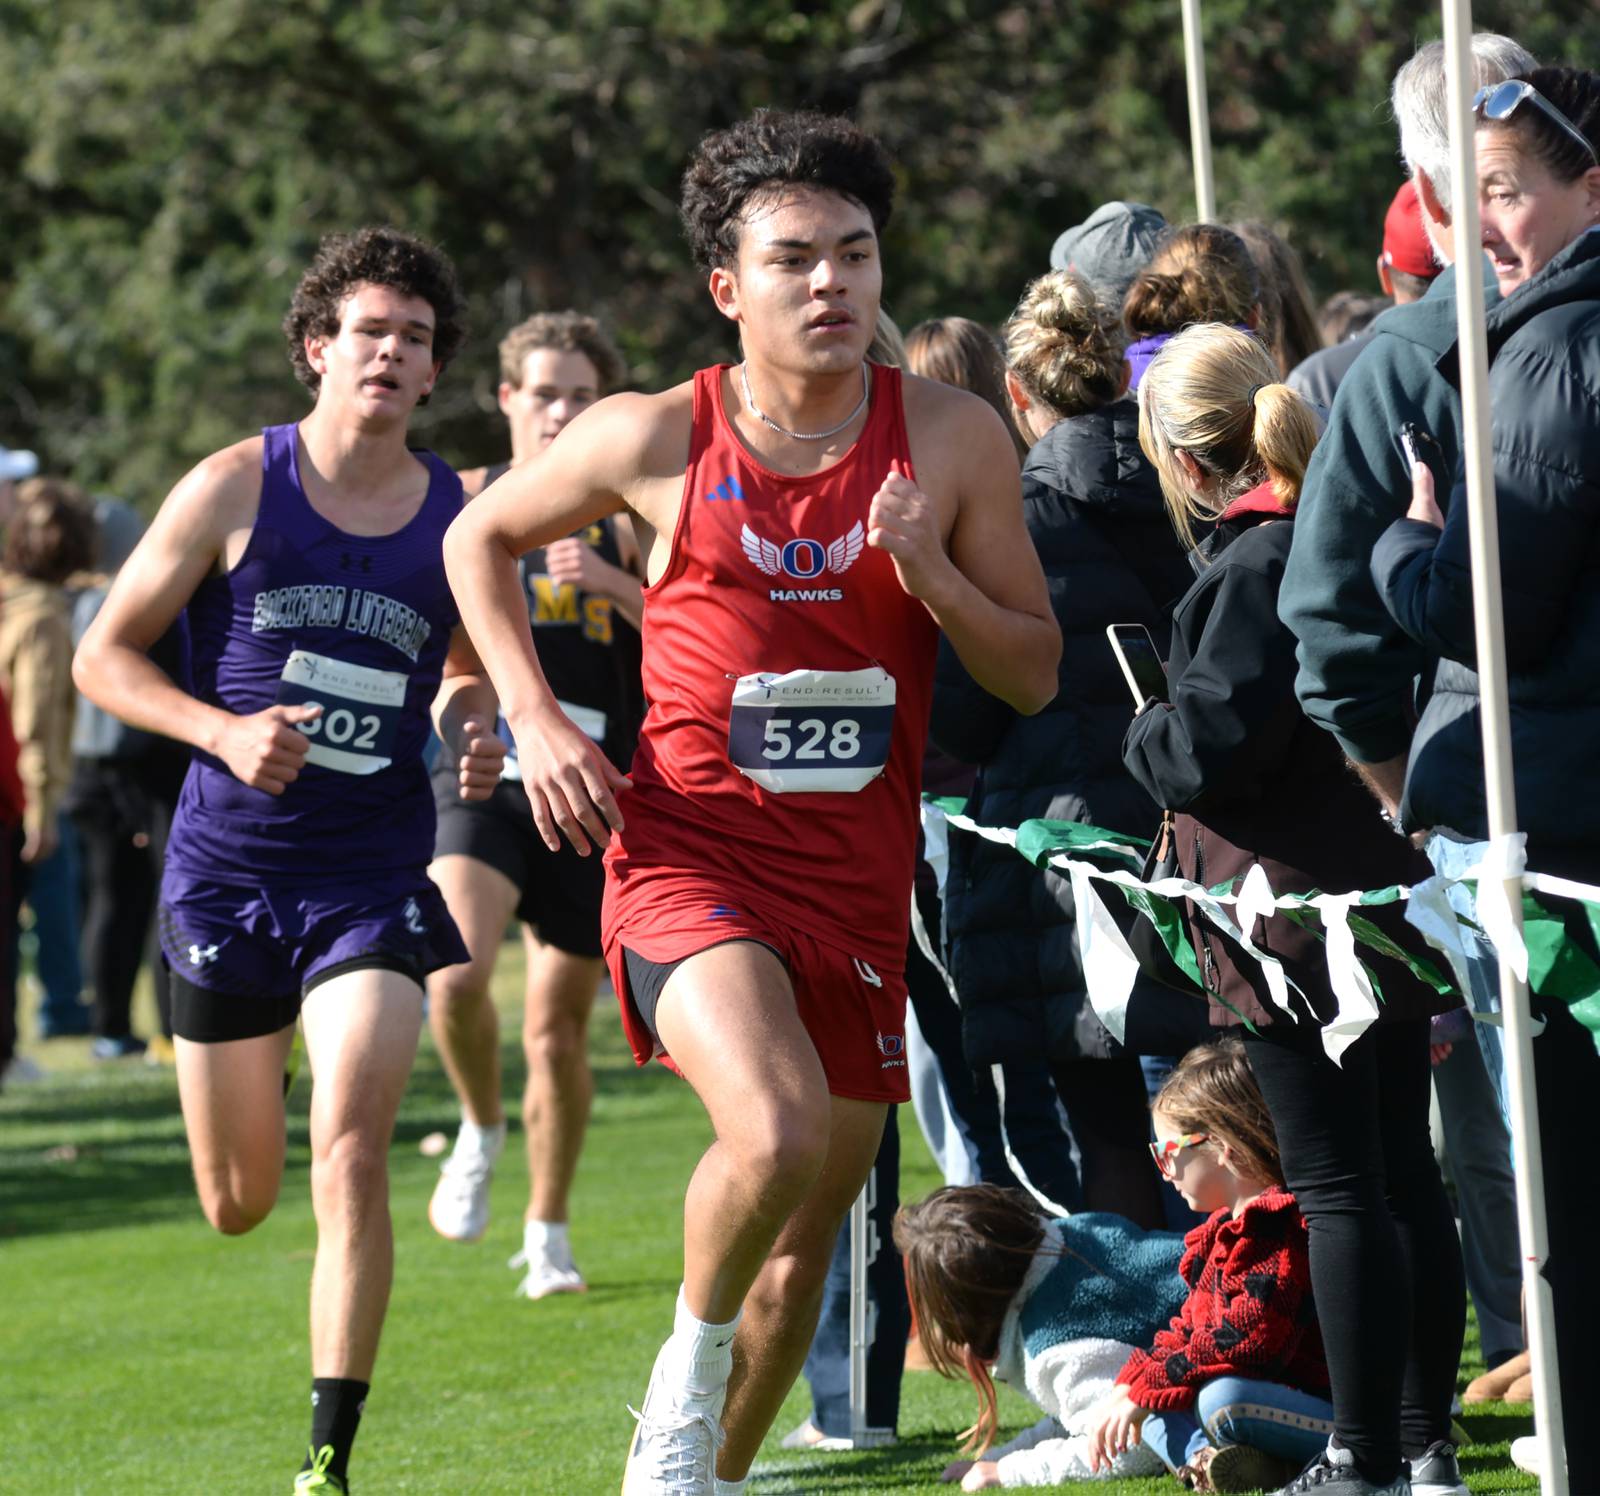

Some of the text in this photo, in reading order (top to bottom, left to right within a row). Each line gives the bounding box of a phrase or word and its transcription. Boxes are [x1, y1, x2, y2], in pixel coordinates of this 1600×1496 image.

[781, 538, 826, 579] O
[769, 588, 843, 602] HAWKS
[252, 584, 432, 664] ROCKFORD LUTHERAN
[782, 685, 881, 695] END RESULT
[761, 718, 861, 761] 528
